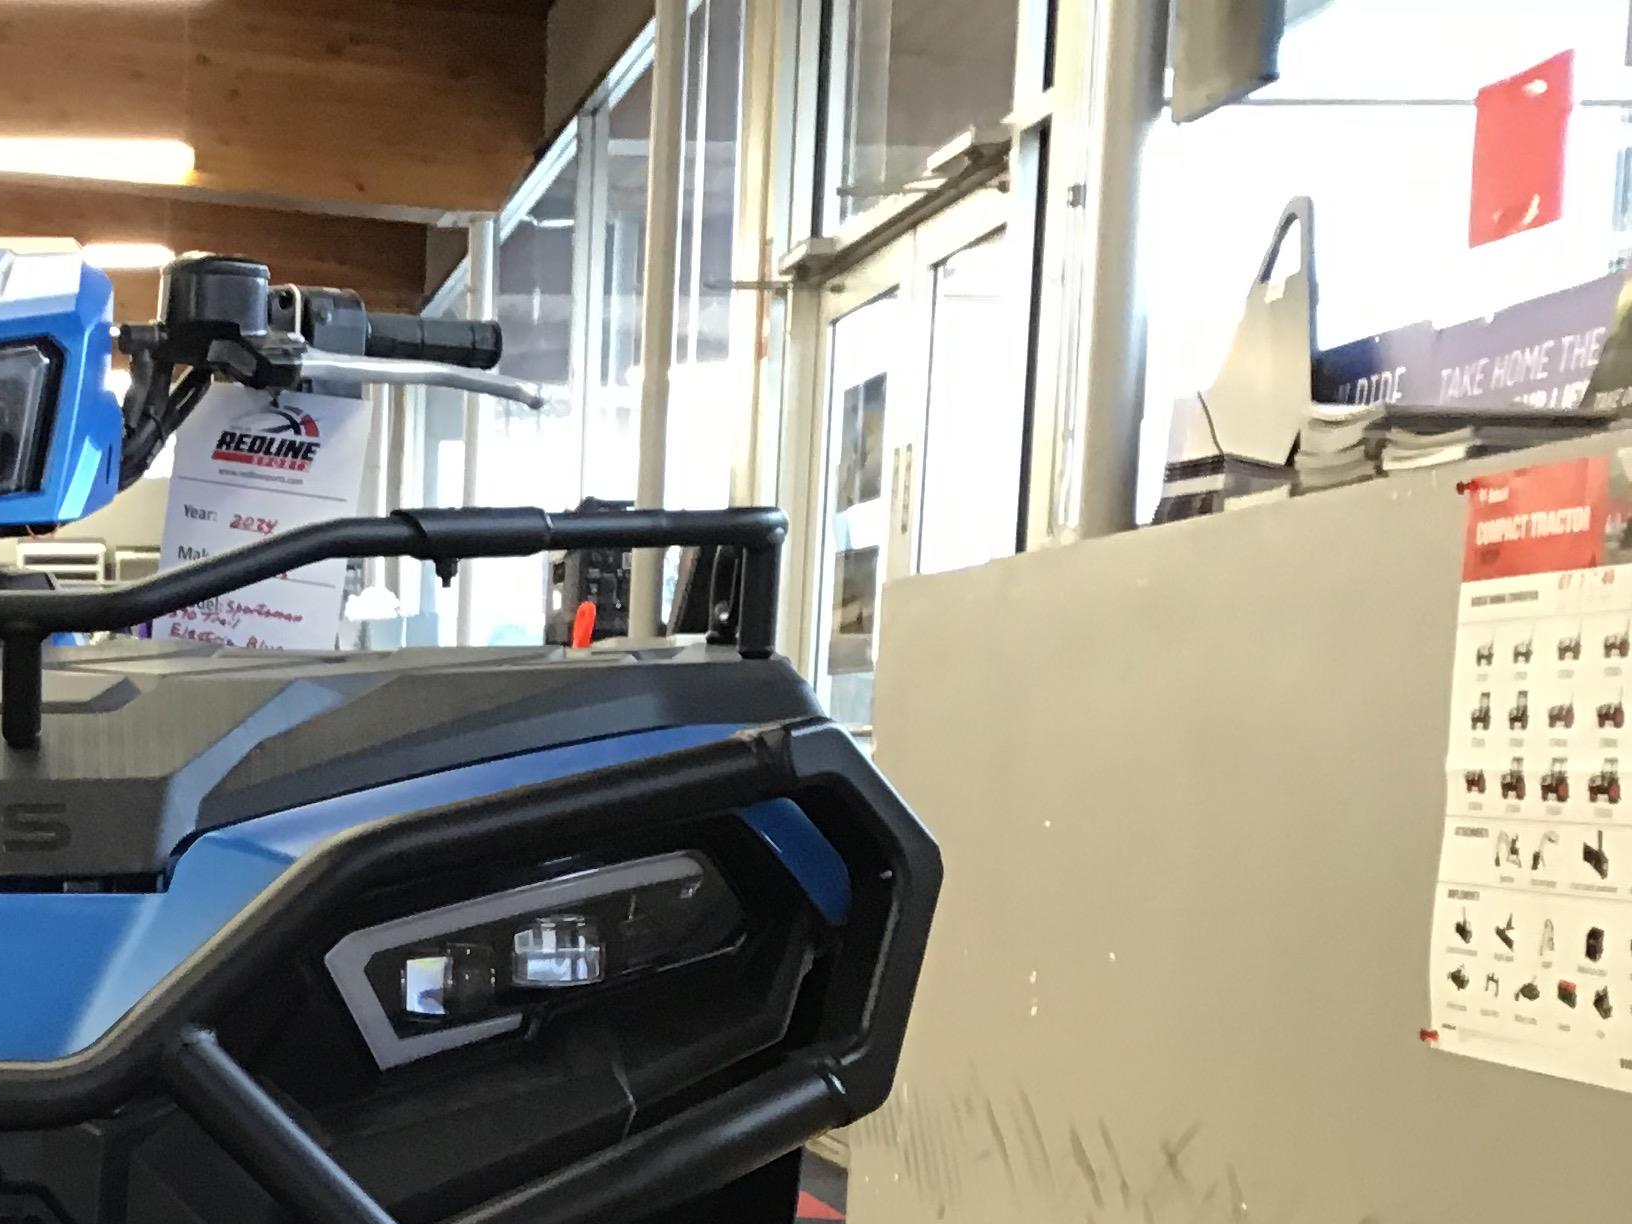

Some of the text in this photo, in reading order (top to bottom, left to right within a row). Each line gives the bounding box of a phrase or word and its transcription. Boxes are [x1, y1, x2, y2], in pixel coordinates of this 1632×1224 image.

[1439, 358, 1490, 404] TAKE
[1491, 340, 1555, 391] HOME
[1560, 326, 1607, 372] THE
[215, 430, 321, 462] REDLINE
[183, 504, 217, 522] Year:
